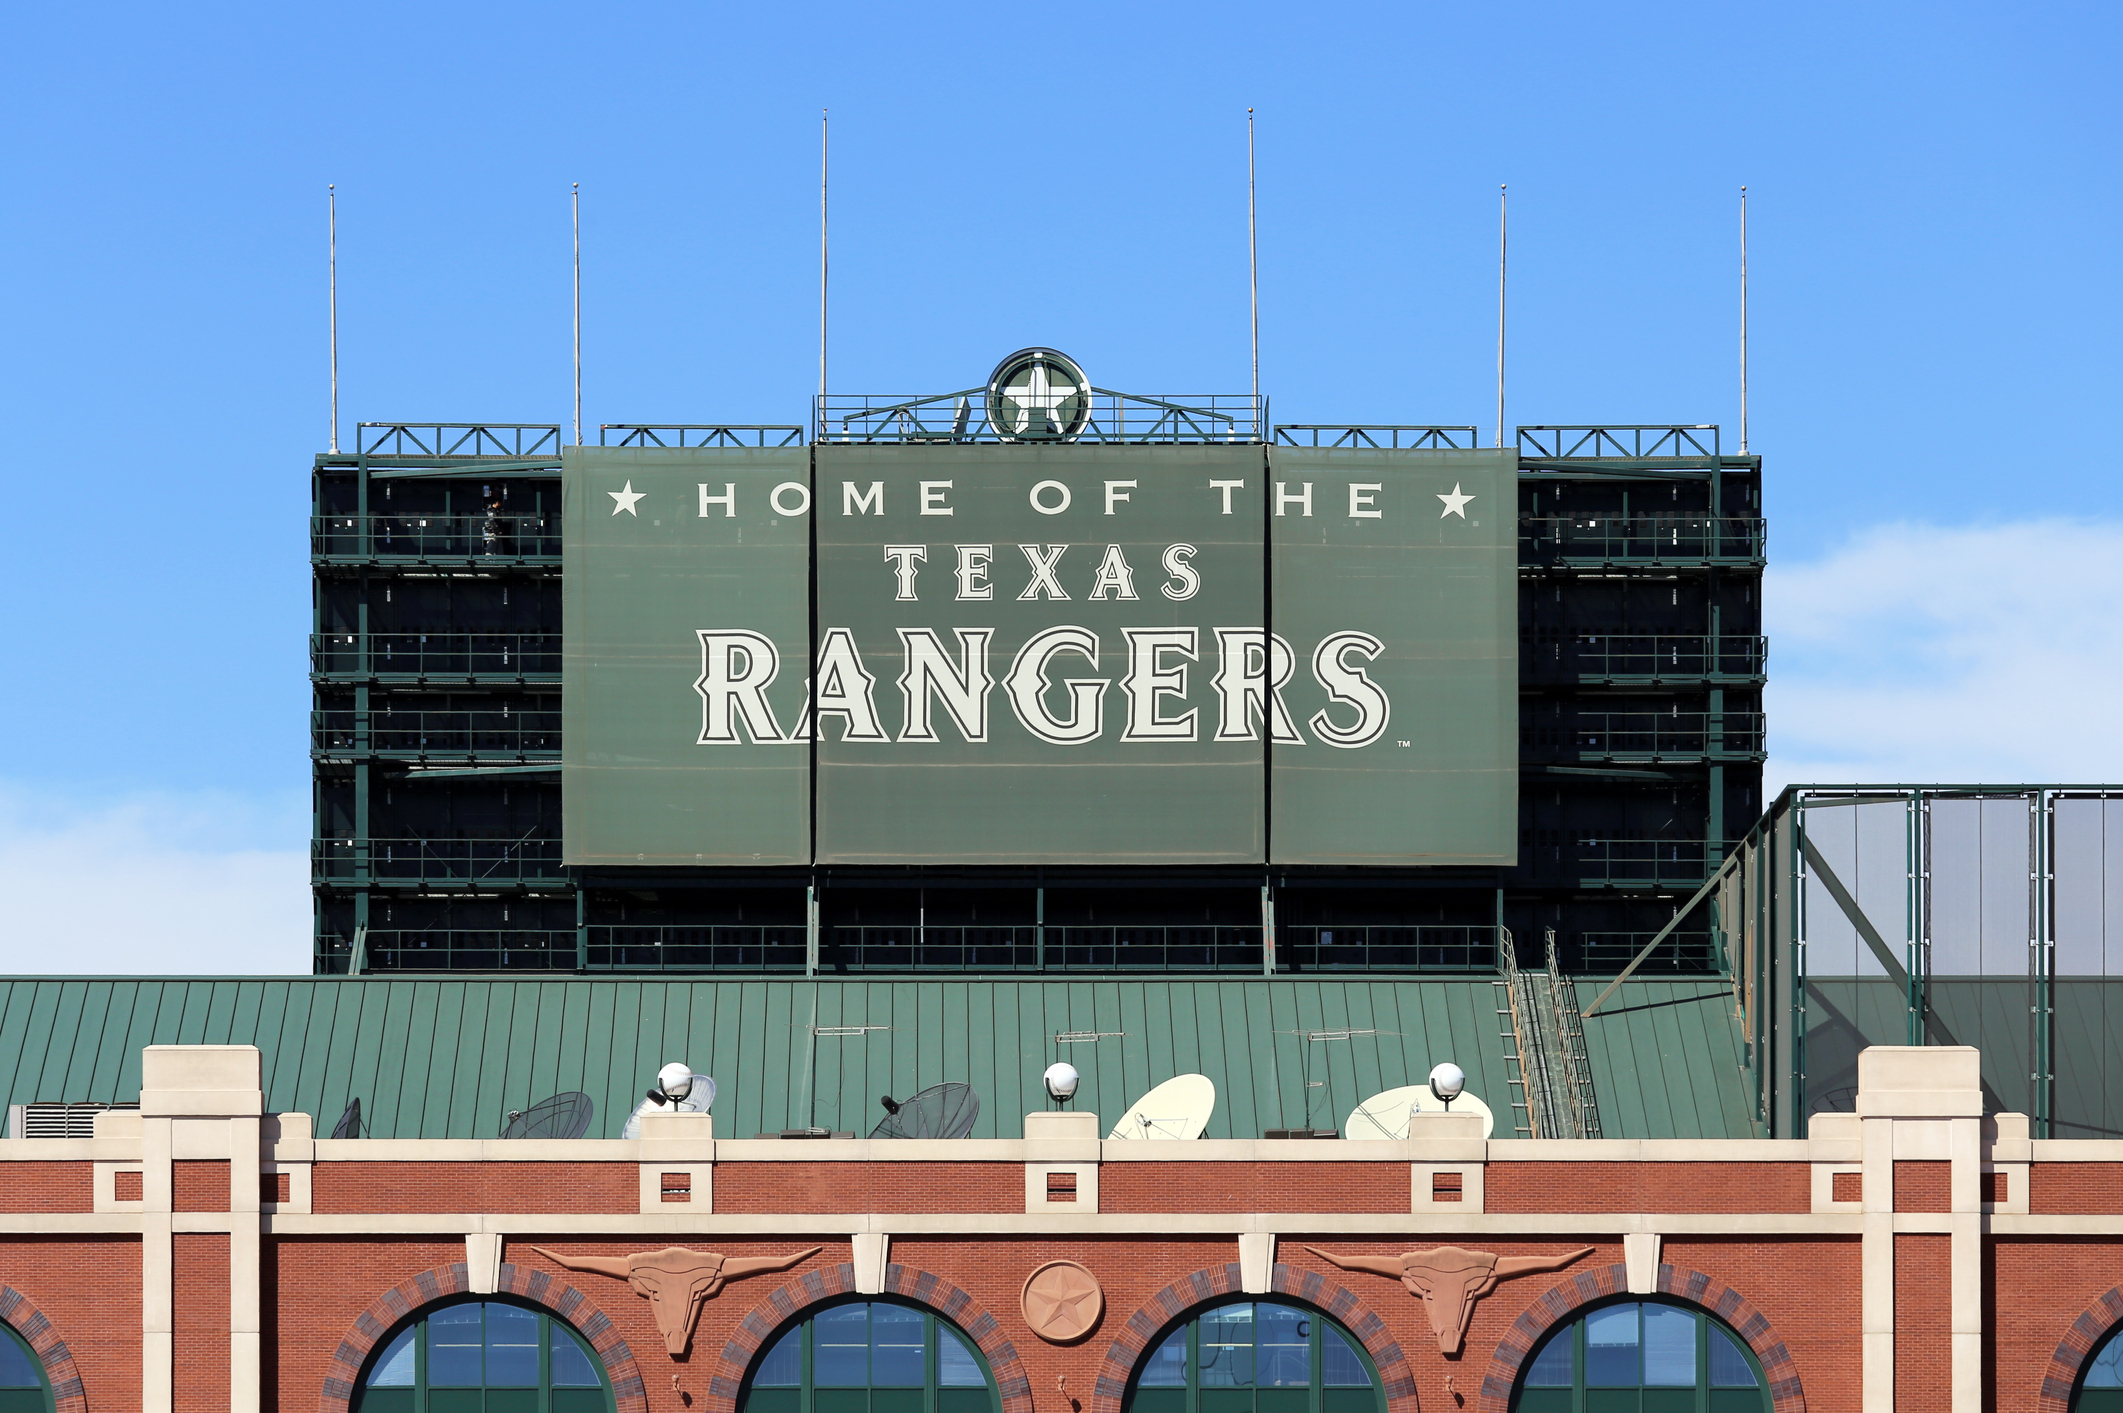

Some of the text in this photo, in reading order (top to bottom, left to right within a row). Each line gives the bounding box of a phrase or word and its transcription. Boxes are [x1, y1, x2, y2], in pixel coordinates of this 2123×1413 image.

[698, 480, 1382, 519] HOME OF THE
[884, 543, 1201, 602] TEXAS
[692, 625, 1391, 749] RANGERS
